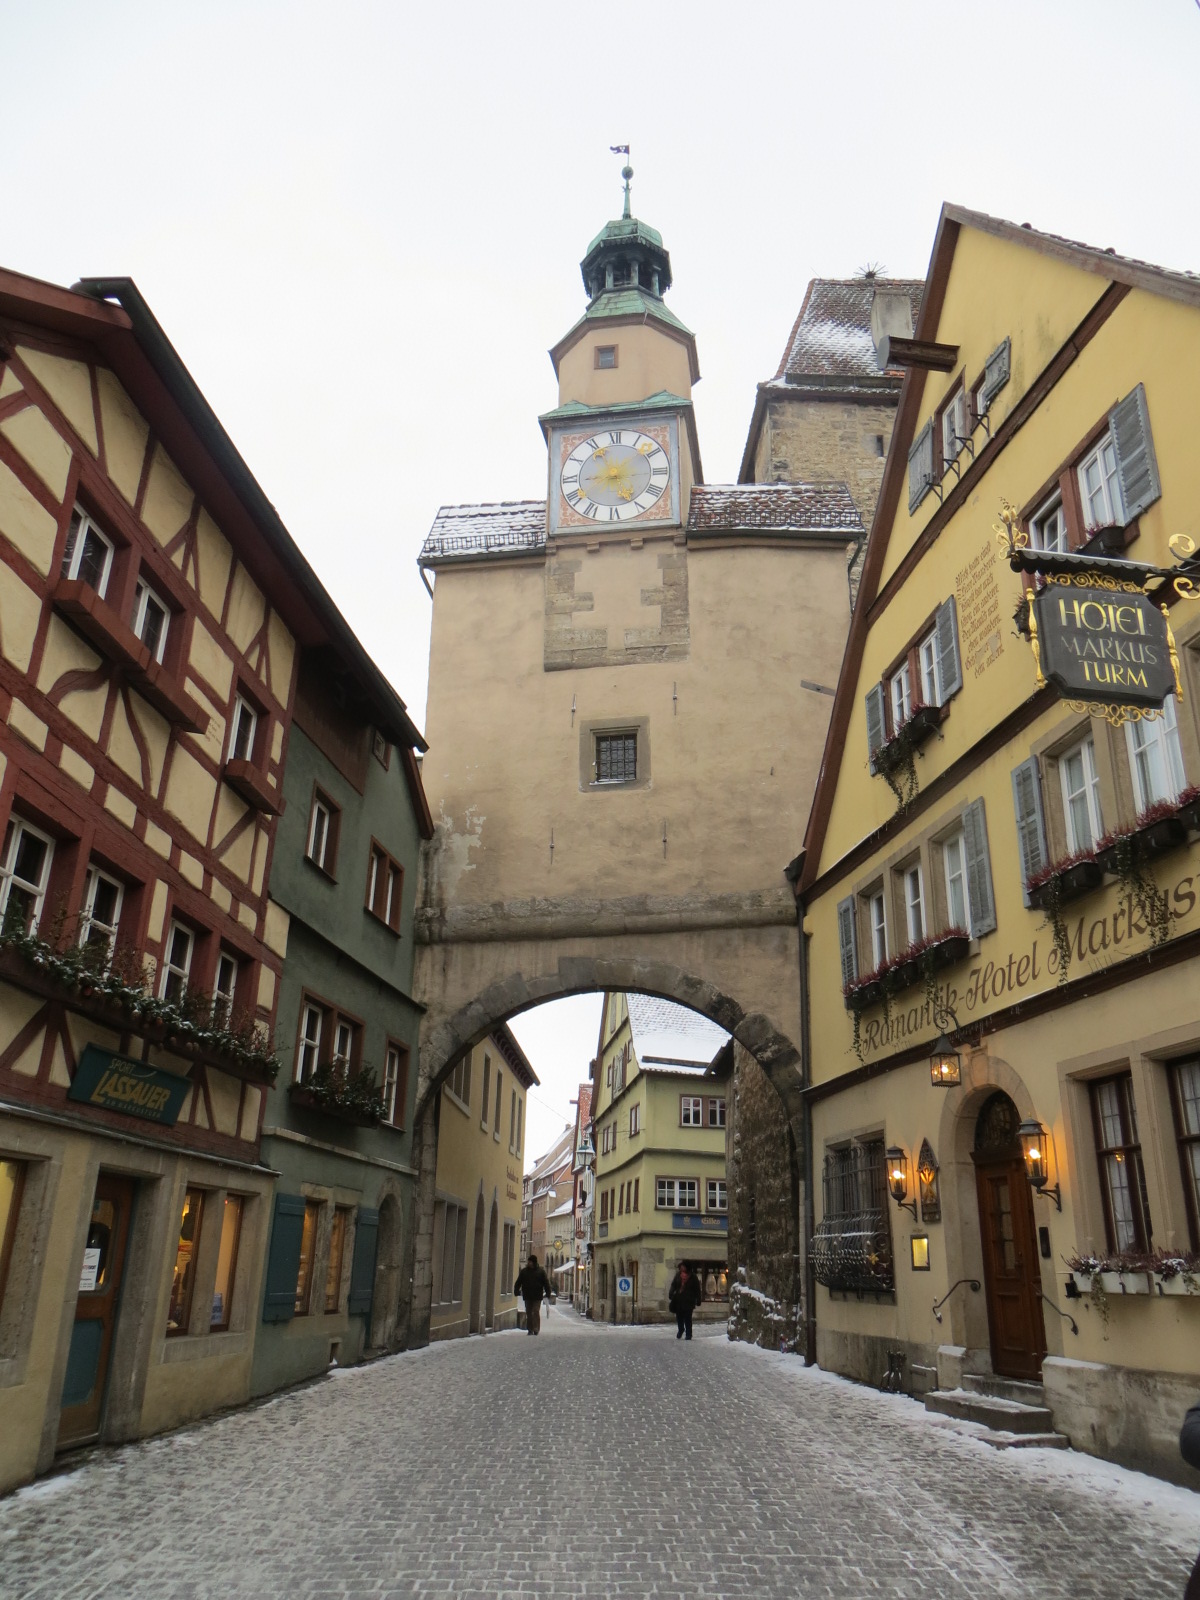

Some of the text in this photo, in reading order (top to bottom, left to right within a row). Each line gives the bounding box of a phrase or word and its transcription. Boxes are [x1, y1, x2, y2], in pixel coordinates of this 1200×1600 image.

[609, 431, 622, 445] XII
[632, 434, 642, 447] I
[646, 446, 661, 458] II
[569, 453, 584, 466] X
[652, 466, 668, 476] III
[562, 474, 578, 485] IX
[633, 500, 647, 514] V
[1058, 598, 1147, 636] HOTEL
[1061, 635, 1158, 665] MARKUS
[1078, 659, 1149, 688] TURM
[1047, 873, 1200, 976] Markus
[108, 1058, 137, 1075] SPORT
[90, 1070, 172, 1112] LASSAUER
